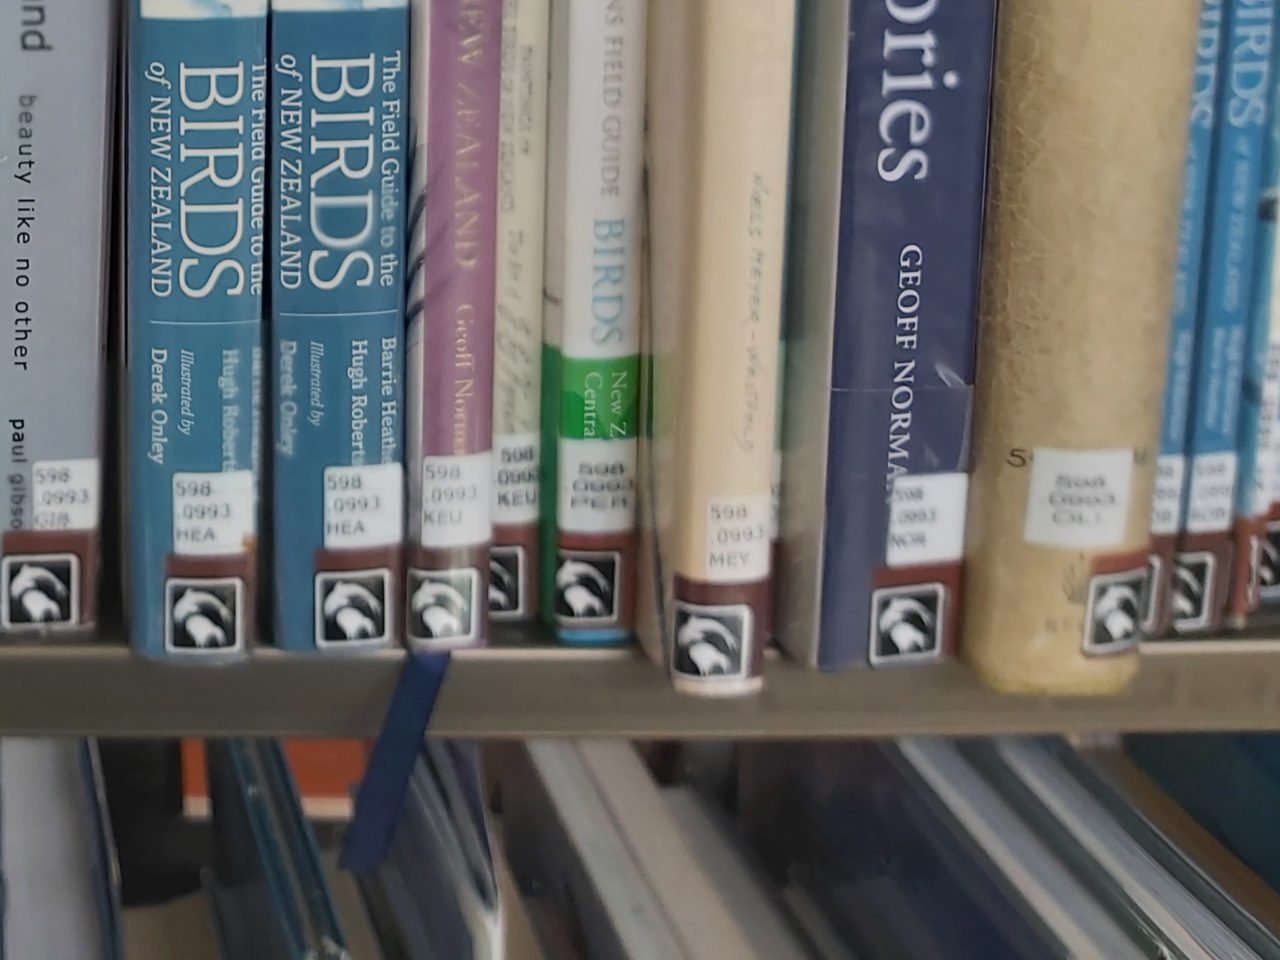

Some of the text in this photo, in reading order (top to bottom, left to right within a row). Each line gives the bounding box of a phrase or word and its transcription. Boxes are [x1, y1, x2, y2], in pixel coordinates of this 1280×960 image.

[602, 35, 624, 110] FIELD
[14, 94, 38, 185] beauty
[274, 54, 303, 290] of NEW ZEALAND
[308, 52, 375, 291] BIRDS
[379, 50, 401, 288] The Field Guide to the
[454, 80, 482, 270] ZEALAND
[600, 114, 622, 199] GUIDE
[145, 61, 172, 298] of NEW ZEALAND
[179, 60, 245, 299] BIRDS
[16, 197, 36, 245] like
[15, 257, 30, 288] no
[591, 218, 625, 345] BIRDS
[14, 301, 32, 371] other
[218, 348, 239, 399] Hugh
[347, 339, 368, 391] Hugh
[380, 336, 397, 396] Barrie
[454, 303, 476, 372] Geoff
[886, 243, 923, 498] GEOFF NORMA
[147, 348, 168, 465] Derek Onley
[177, 348, 195, 436] Illustrated by
[276, 340, 298, 457] Derek Onley
[306, 340, 324, 427] Illustrated by
[610, 371, 628, 416] New
[8, 418, 28, 463] paul
[425, 464, 461, 479] 598
[176, 480, 211, 497] 598
[326, 474, 362, 490] 598
[176, 526, 216, 542] HEA
[326, 519, 365, 536] HEA
